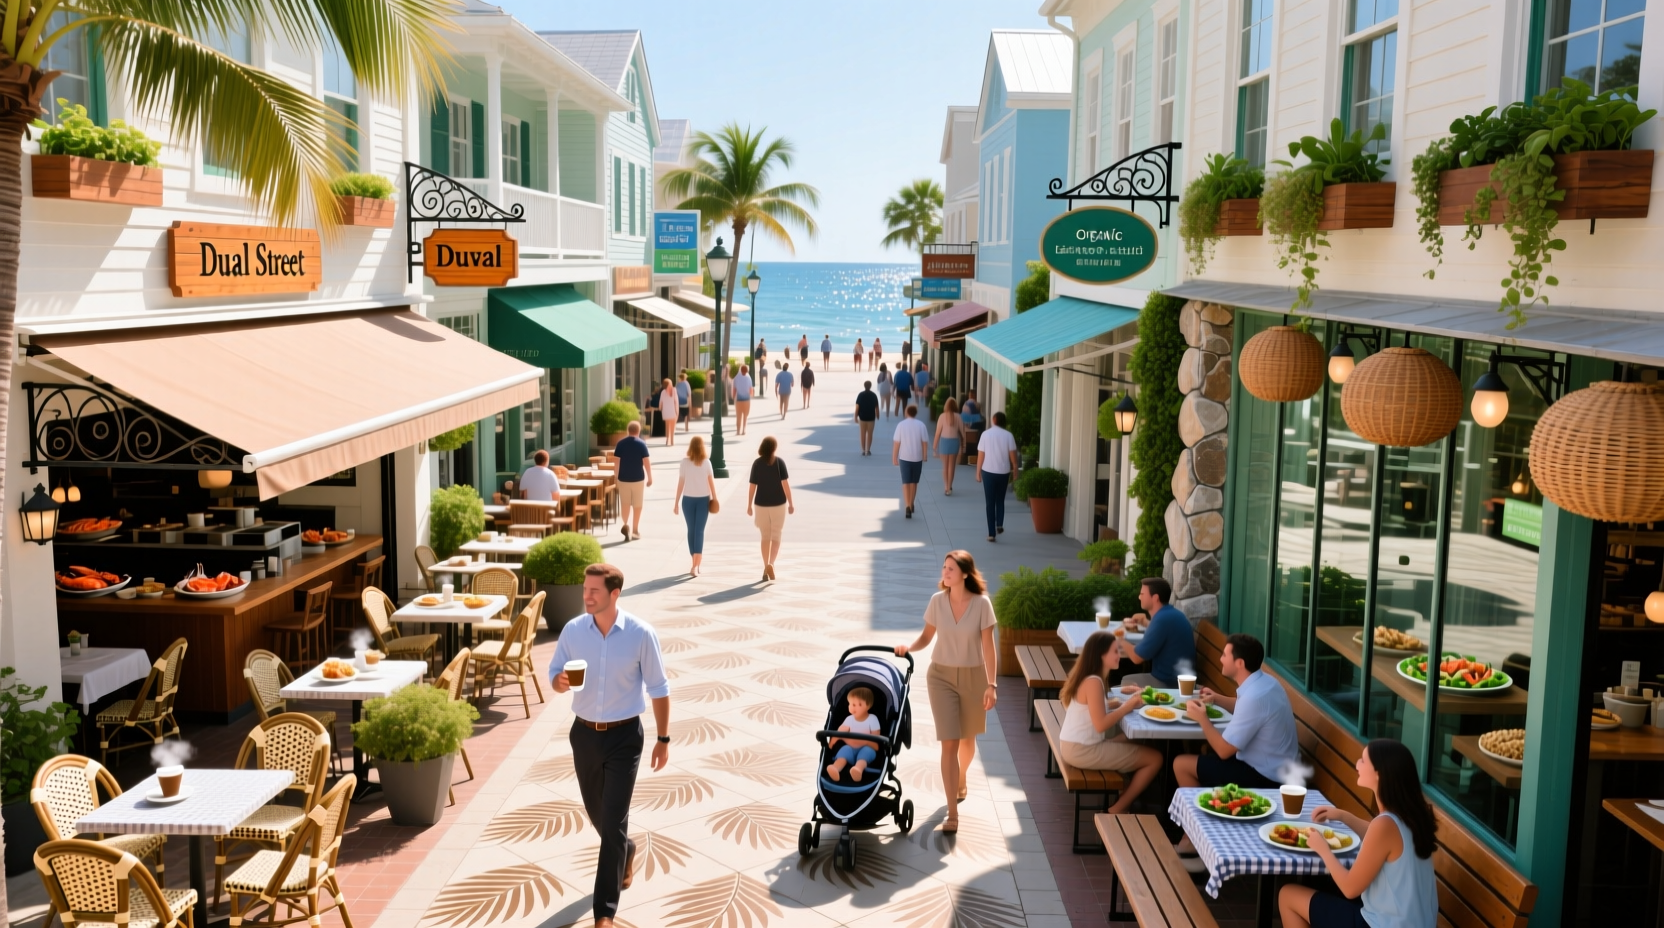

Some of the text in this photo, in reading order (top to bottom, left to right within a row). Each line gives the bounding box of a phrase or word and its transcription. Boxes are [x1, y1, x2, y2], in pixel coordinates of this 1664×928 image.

[200, 242, 305, 277] Dual Street
[436, 244, 502, 267] Duval
